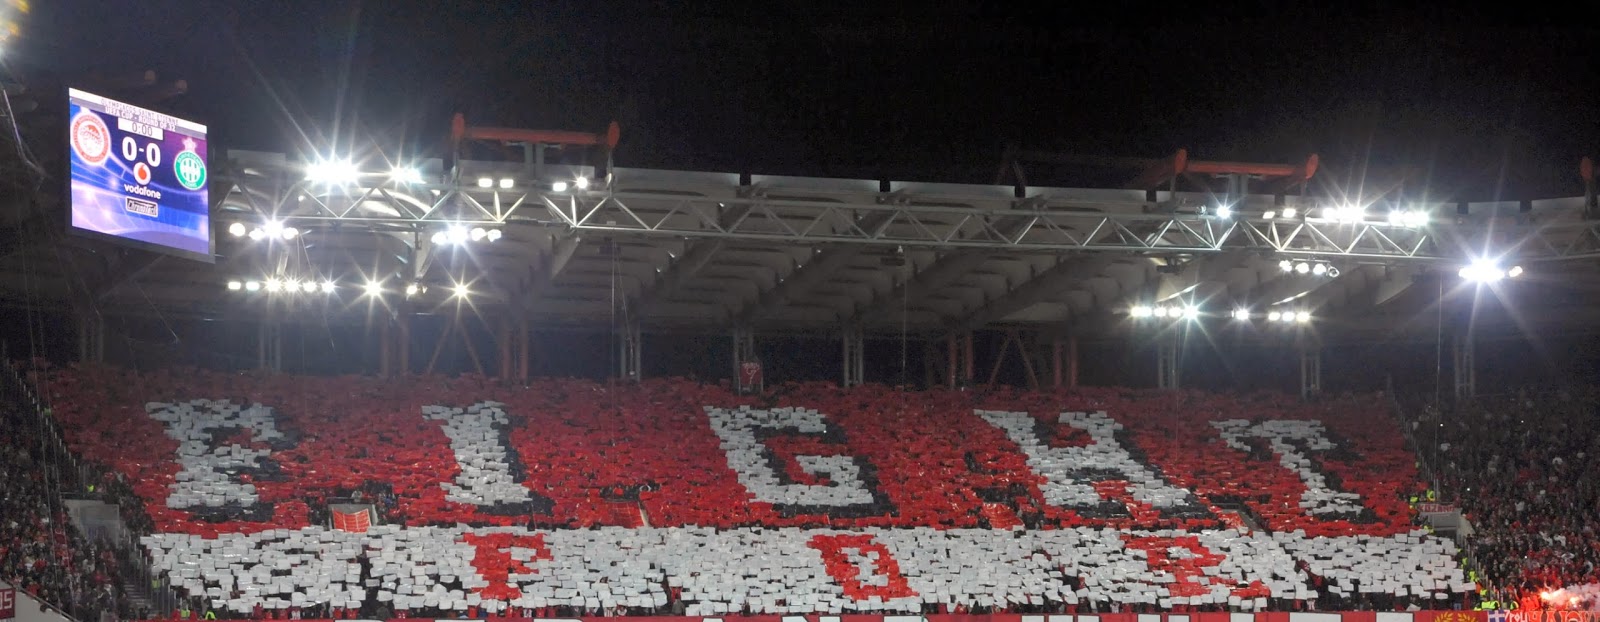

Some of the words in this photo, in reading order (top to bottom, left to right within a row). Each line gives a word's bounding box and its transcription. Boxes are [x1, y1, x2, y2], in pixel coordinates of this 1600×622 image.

[105, 106, 120, 117] UEFA
[138, 114, 158, 127] ROUND
[132, 122, 152, 136] 0:00
[124, 184, 161, 199] vodafone
